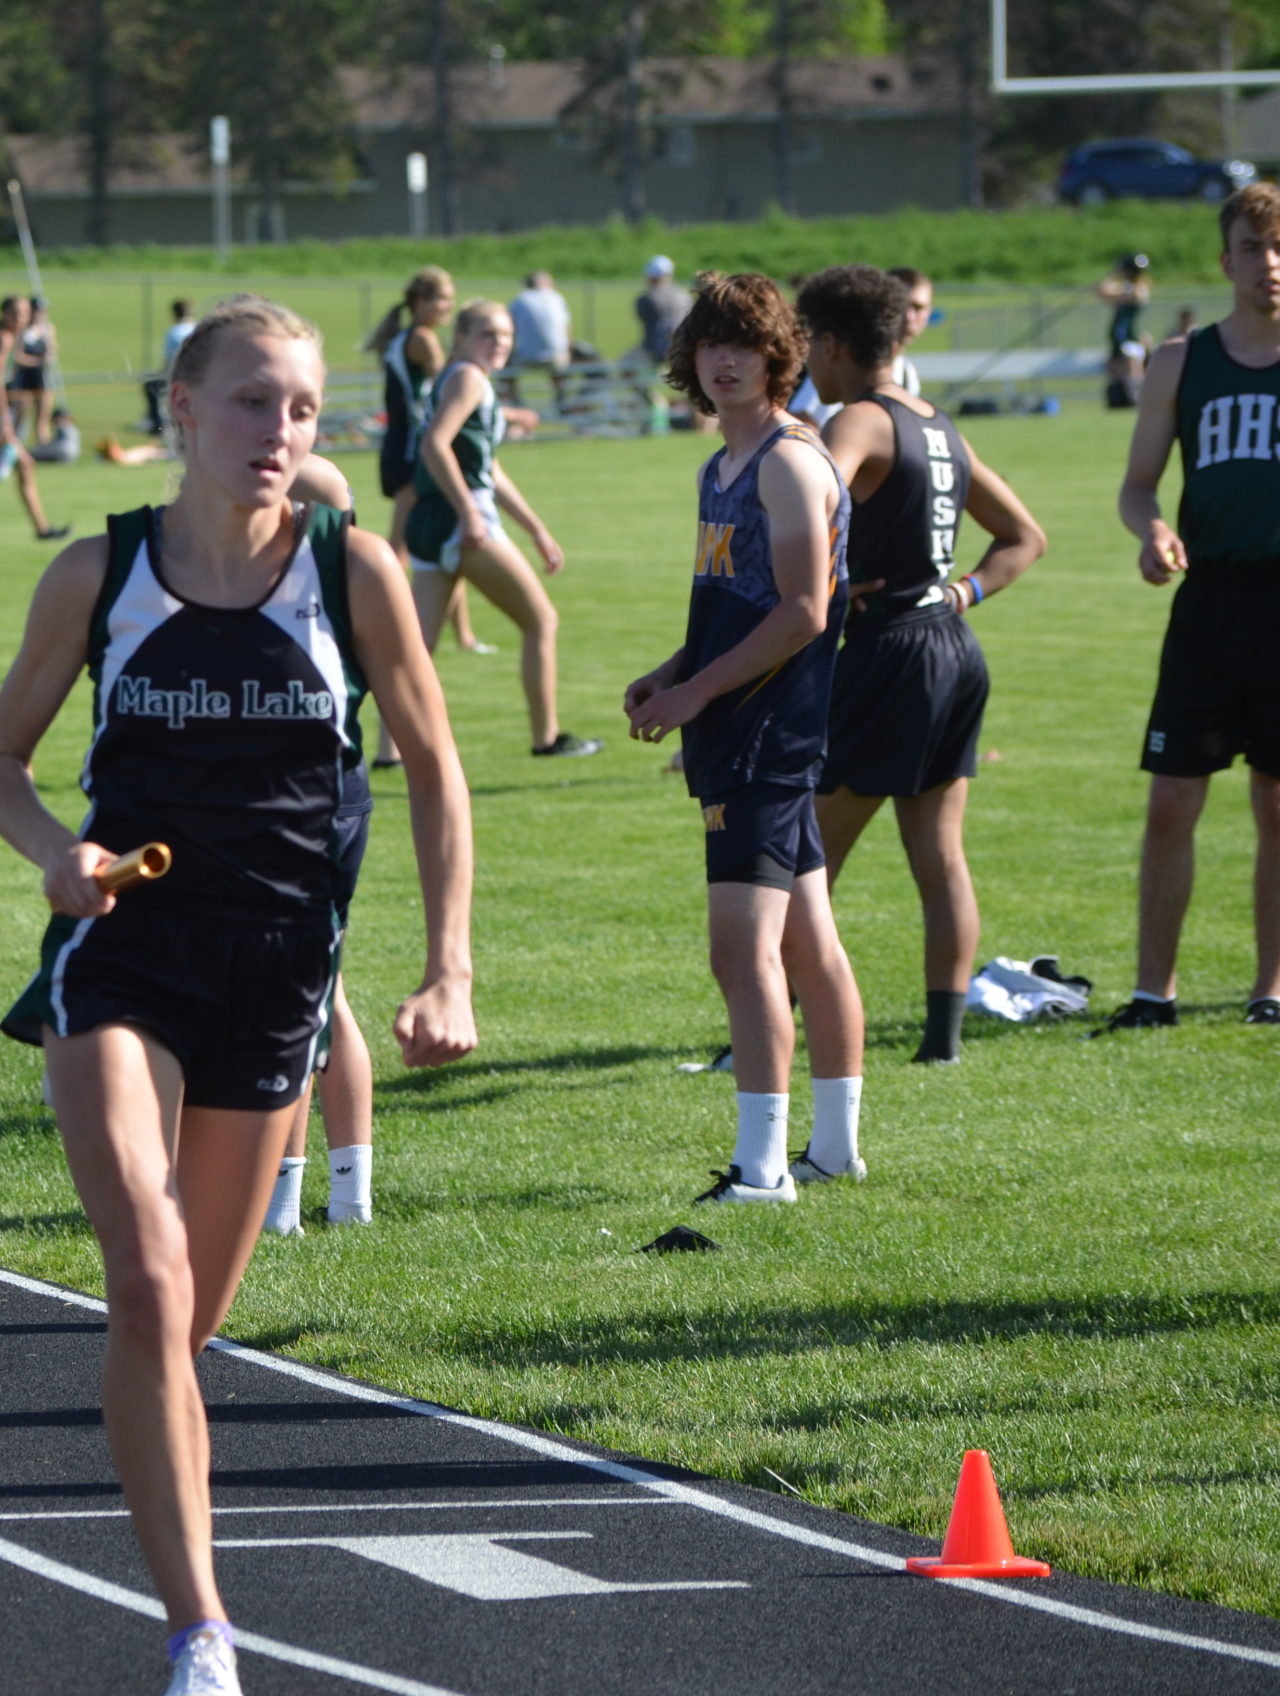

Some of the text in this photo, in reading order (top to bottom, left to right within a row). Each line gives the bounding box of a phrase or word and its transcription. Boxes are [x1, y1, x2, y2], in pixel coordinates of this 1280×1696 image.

[1196, 393, 1280, 470] HH
[117, 675, 334, 729] Maple Lake
